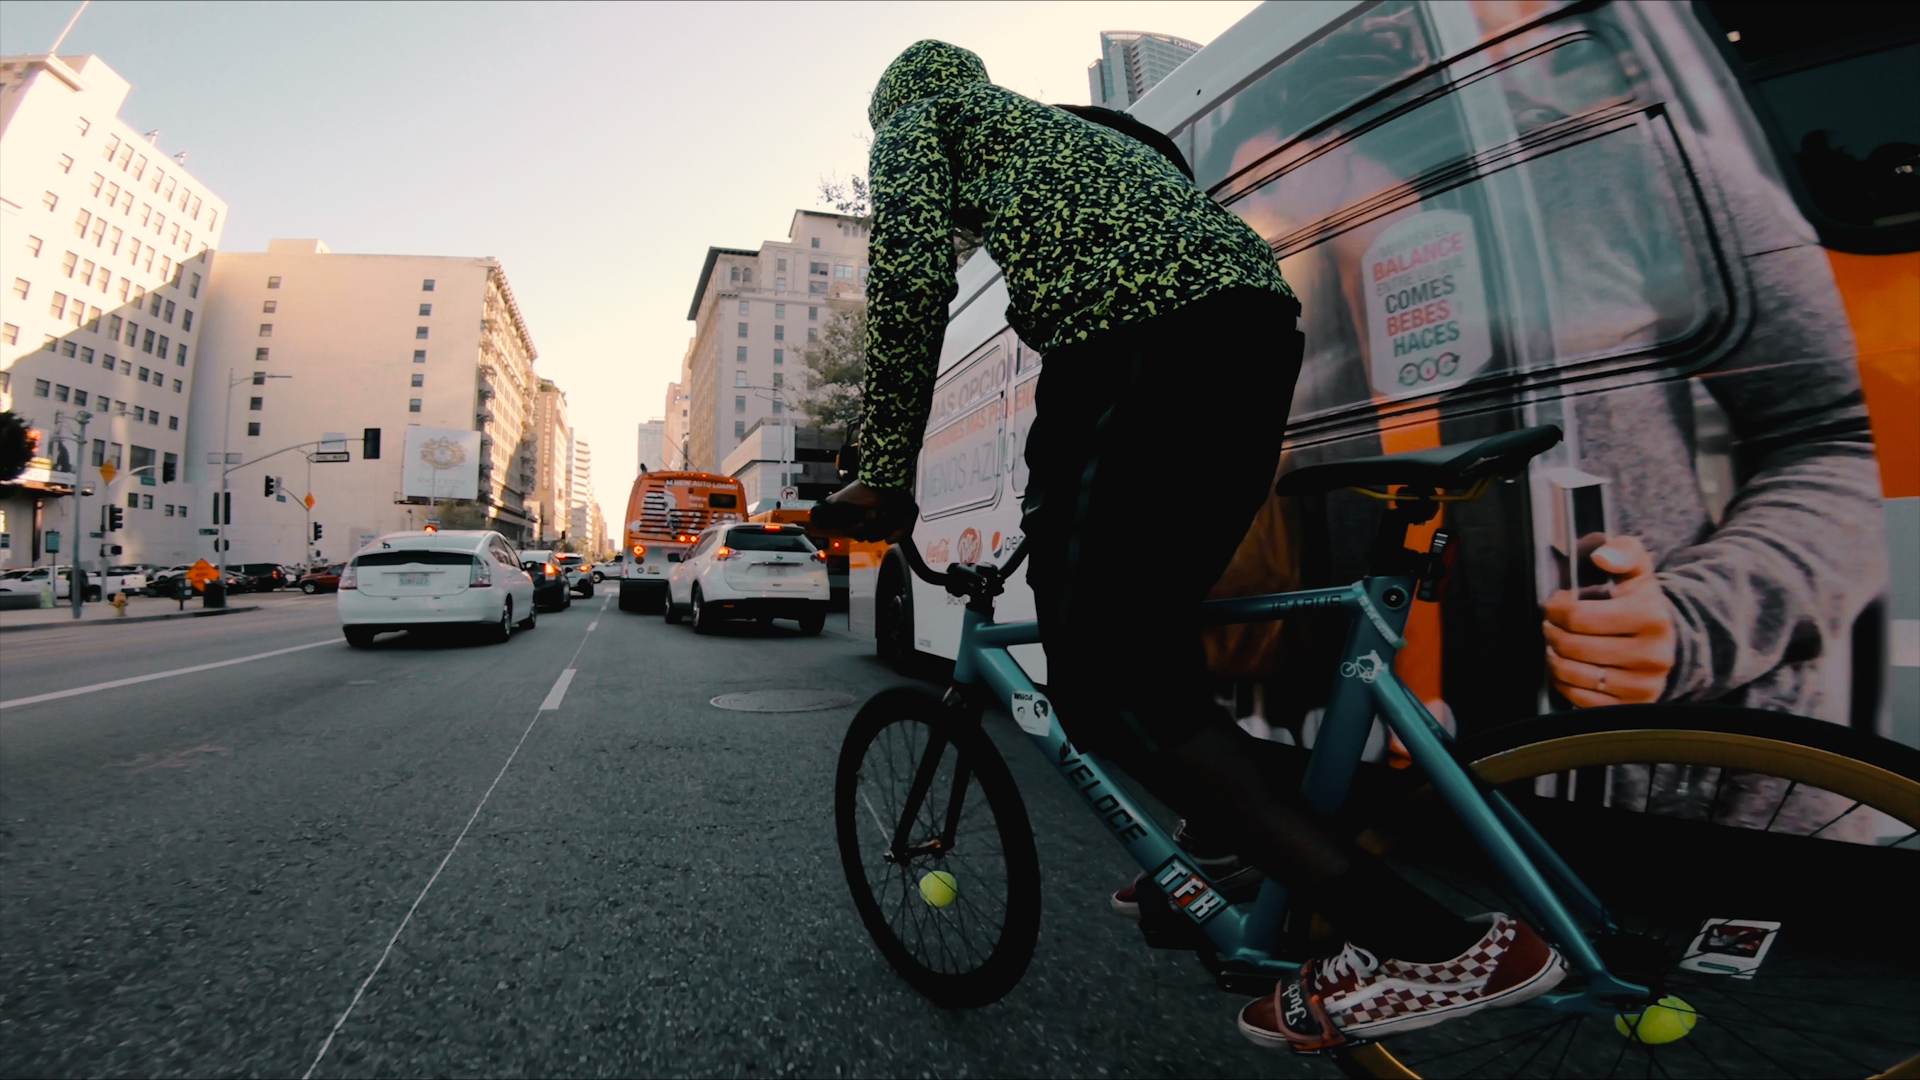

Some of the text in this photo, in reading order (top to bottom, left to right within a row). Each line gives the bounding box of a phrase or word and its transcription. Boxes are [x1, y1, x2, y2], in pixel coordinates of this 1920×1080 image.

[1373, 232, 1464, 283] BALANCE
[1385, 274, 1456, 314] COMES
[1386, 299, 1450, 337] BEBES
[1393, 320, 1460, 358] HACES
[692, 480, 712, 488] AUTO
[1059, 757, 1148, 845] VELOCE
